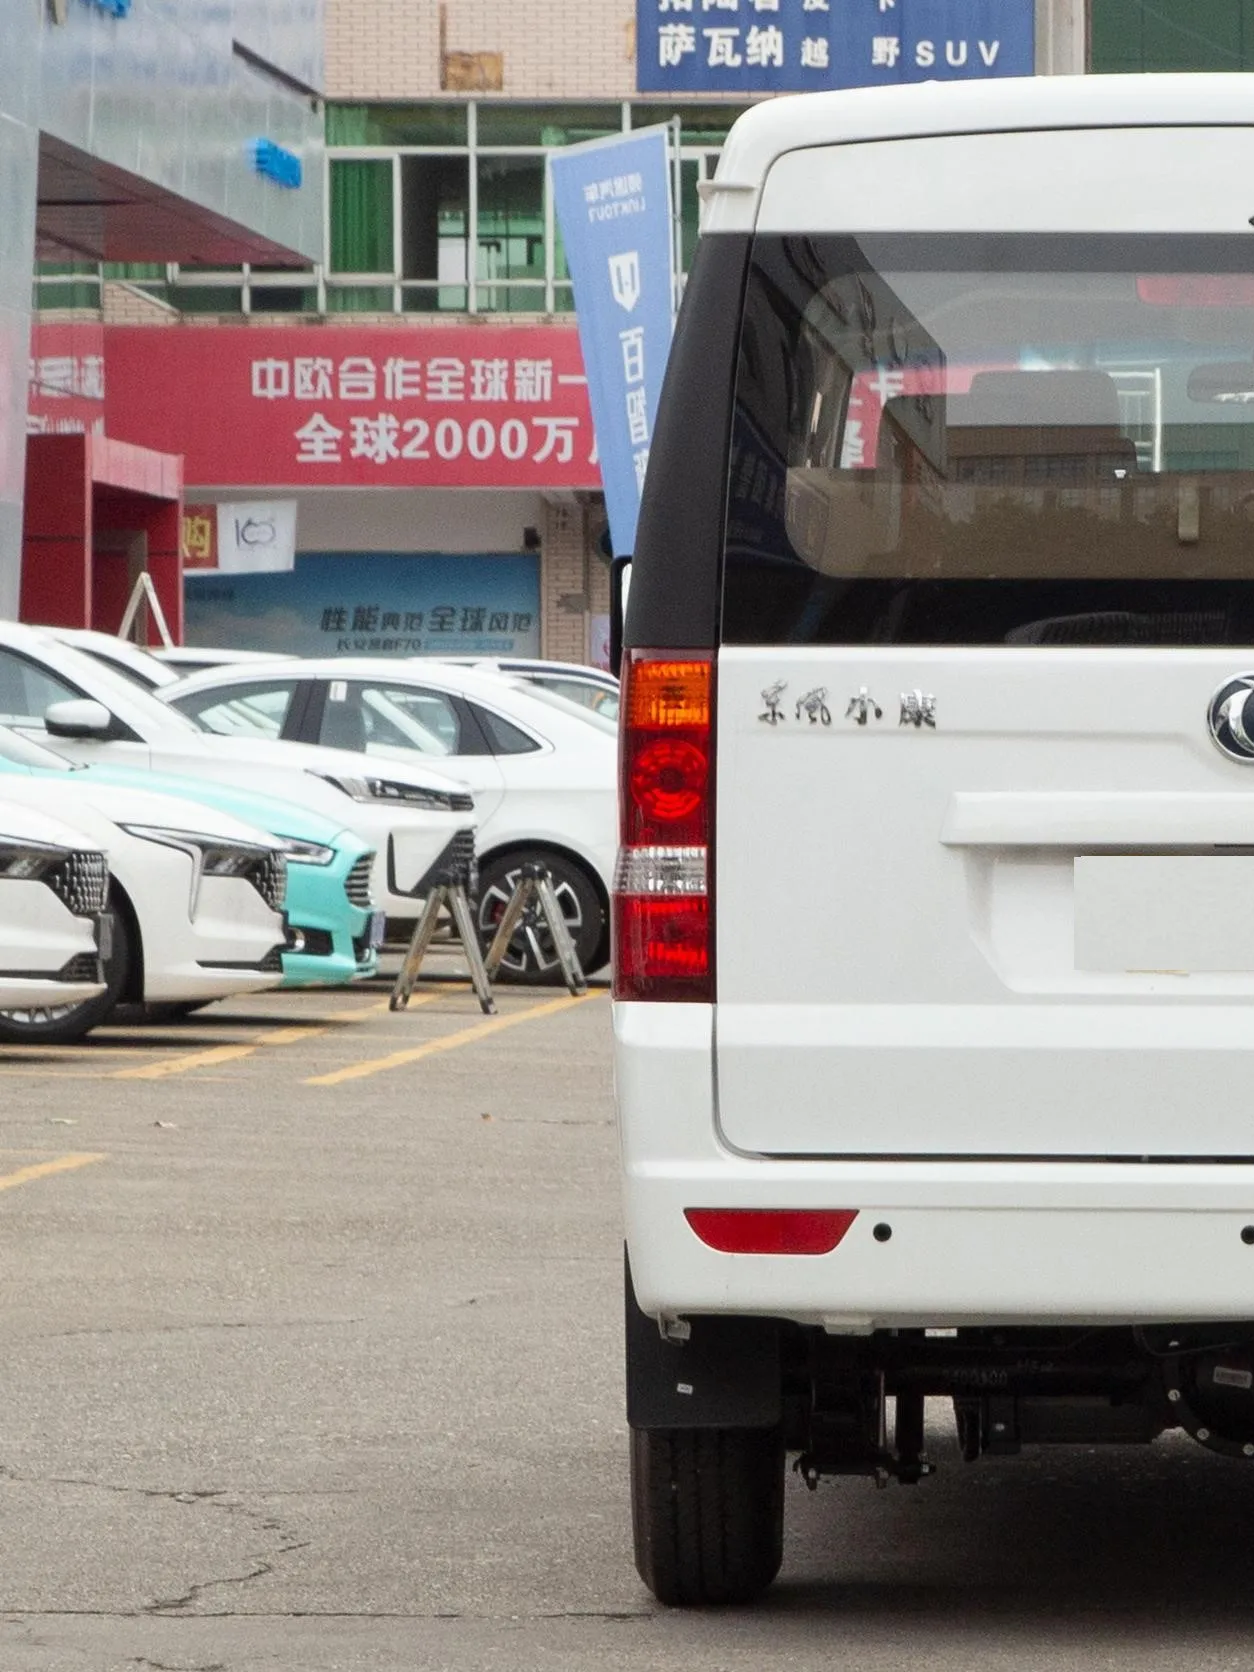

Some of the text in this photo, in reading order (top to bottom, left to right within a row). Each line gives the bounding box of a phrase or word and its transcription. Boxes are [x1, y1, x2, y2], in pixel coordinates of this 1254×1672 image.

[658, 24, 784, 67] 萨瓦纳
[252, 357, 588, 401] 中欧合作全球新一
[295, 412, 600, 464] 全球2000万
